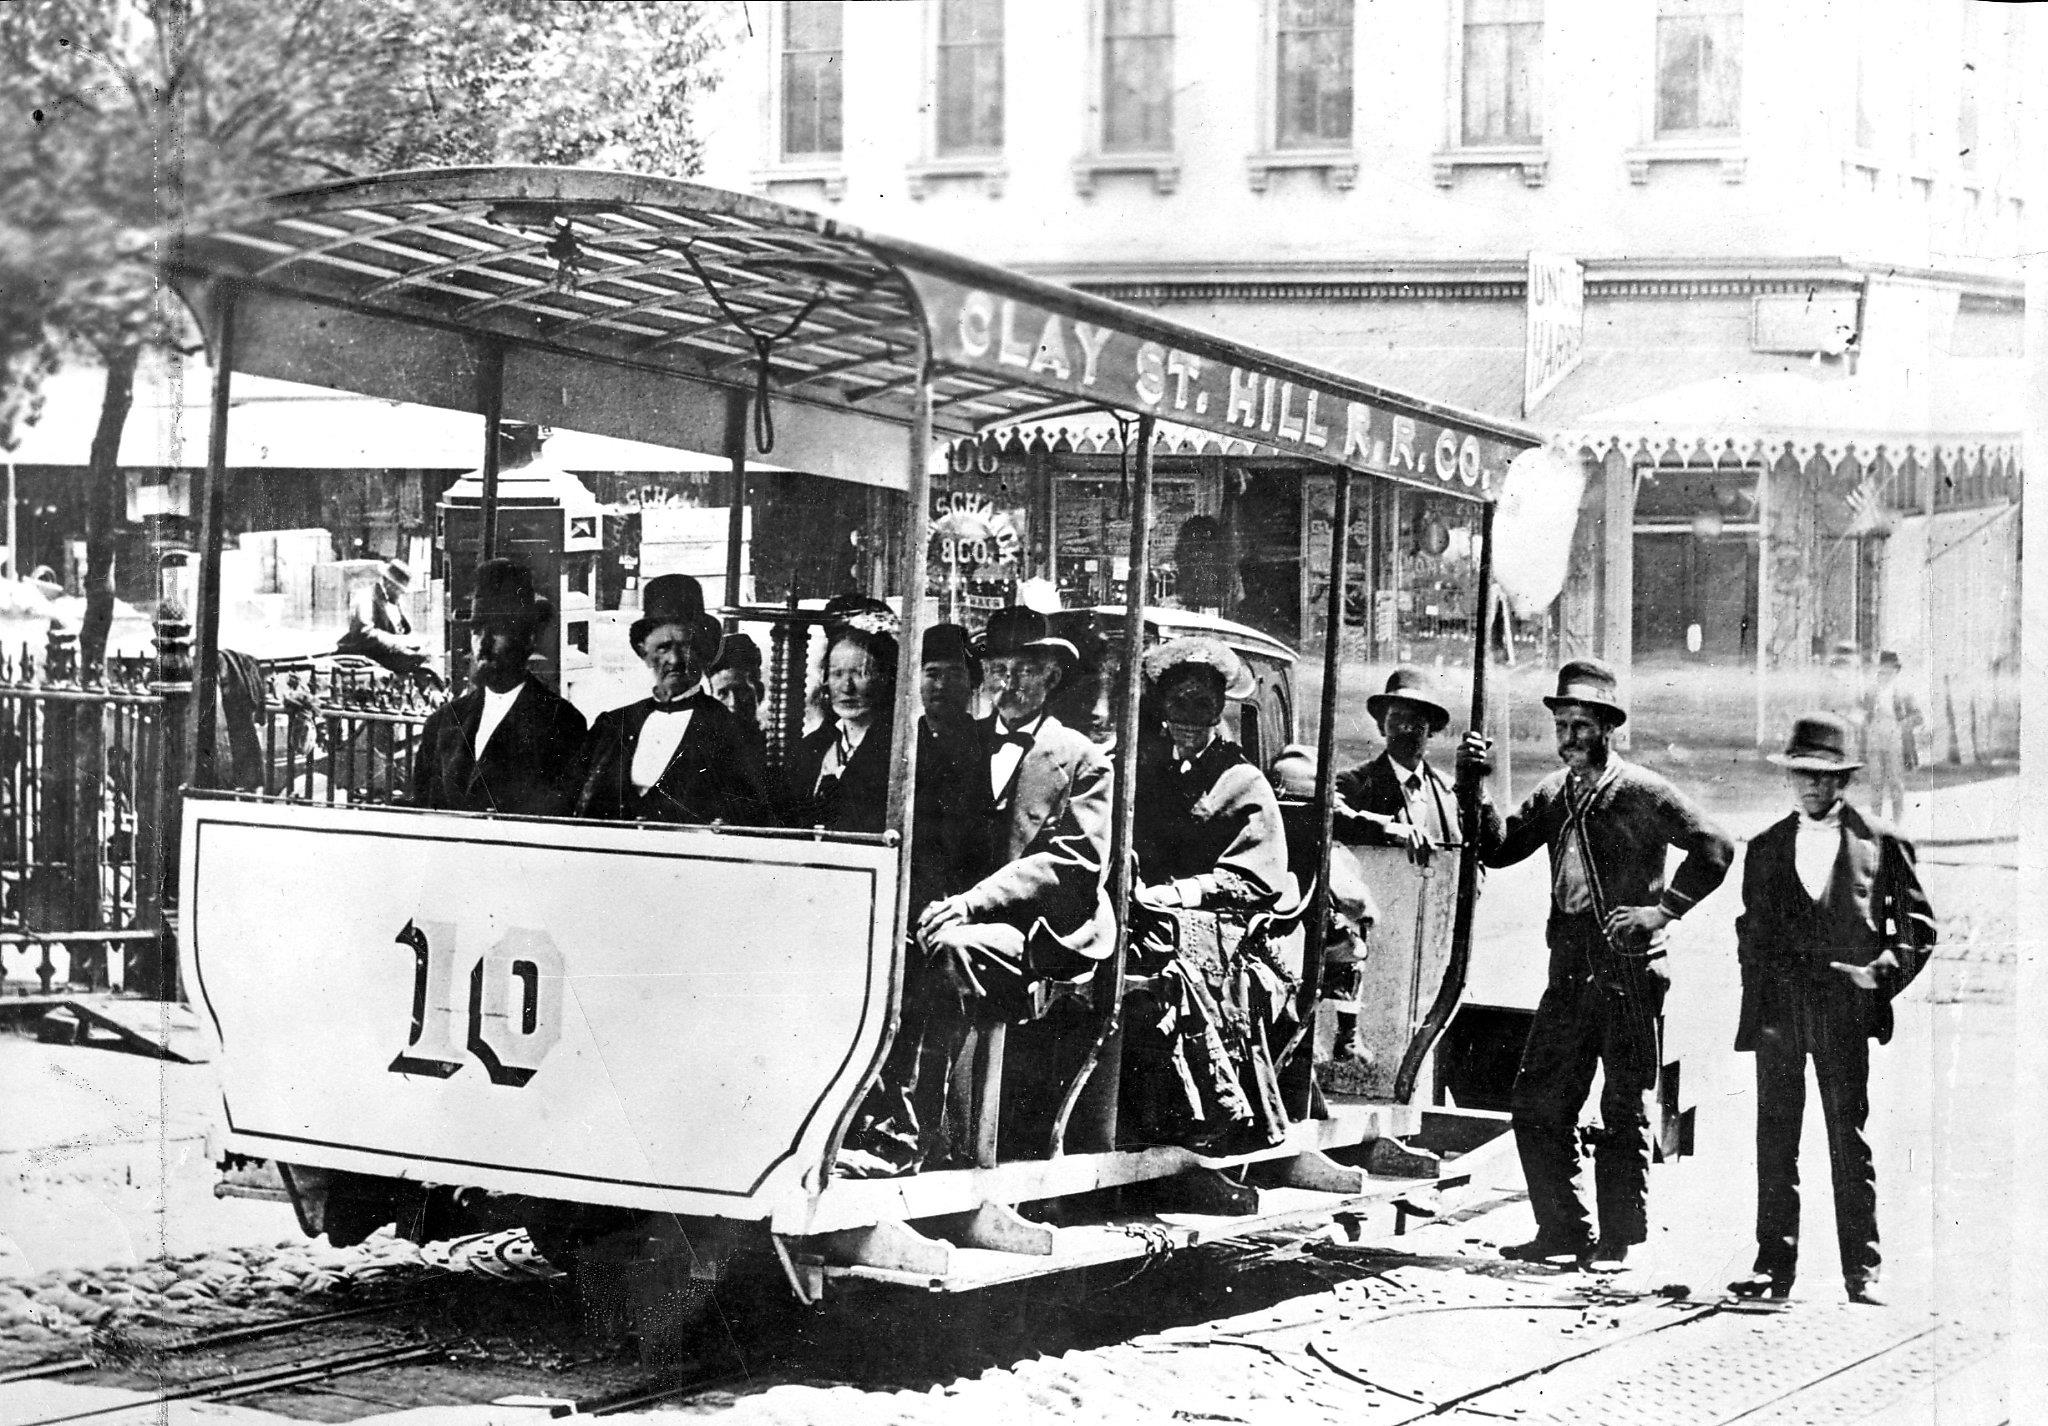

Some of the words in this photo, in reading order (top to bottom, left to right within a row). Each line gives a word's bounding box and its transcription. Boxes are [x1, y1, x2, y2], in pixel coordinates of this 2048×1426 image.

[959, 289, 1114, 386] CLAY
[1135, 341, 1209, 415] ST.
[1226, 366, 1329, 448] HILL
[388, 917, 565, 1088] 10
